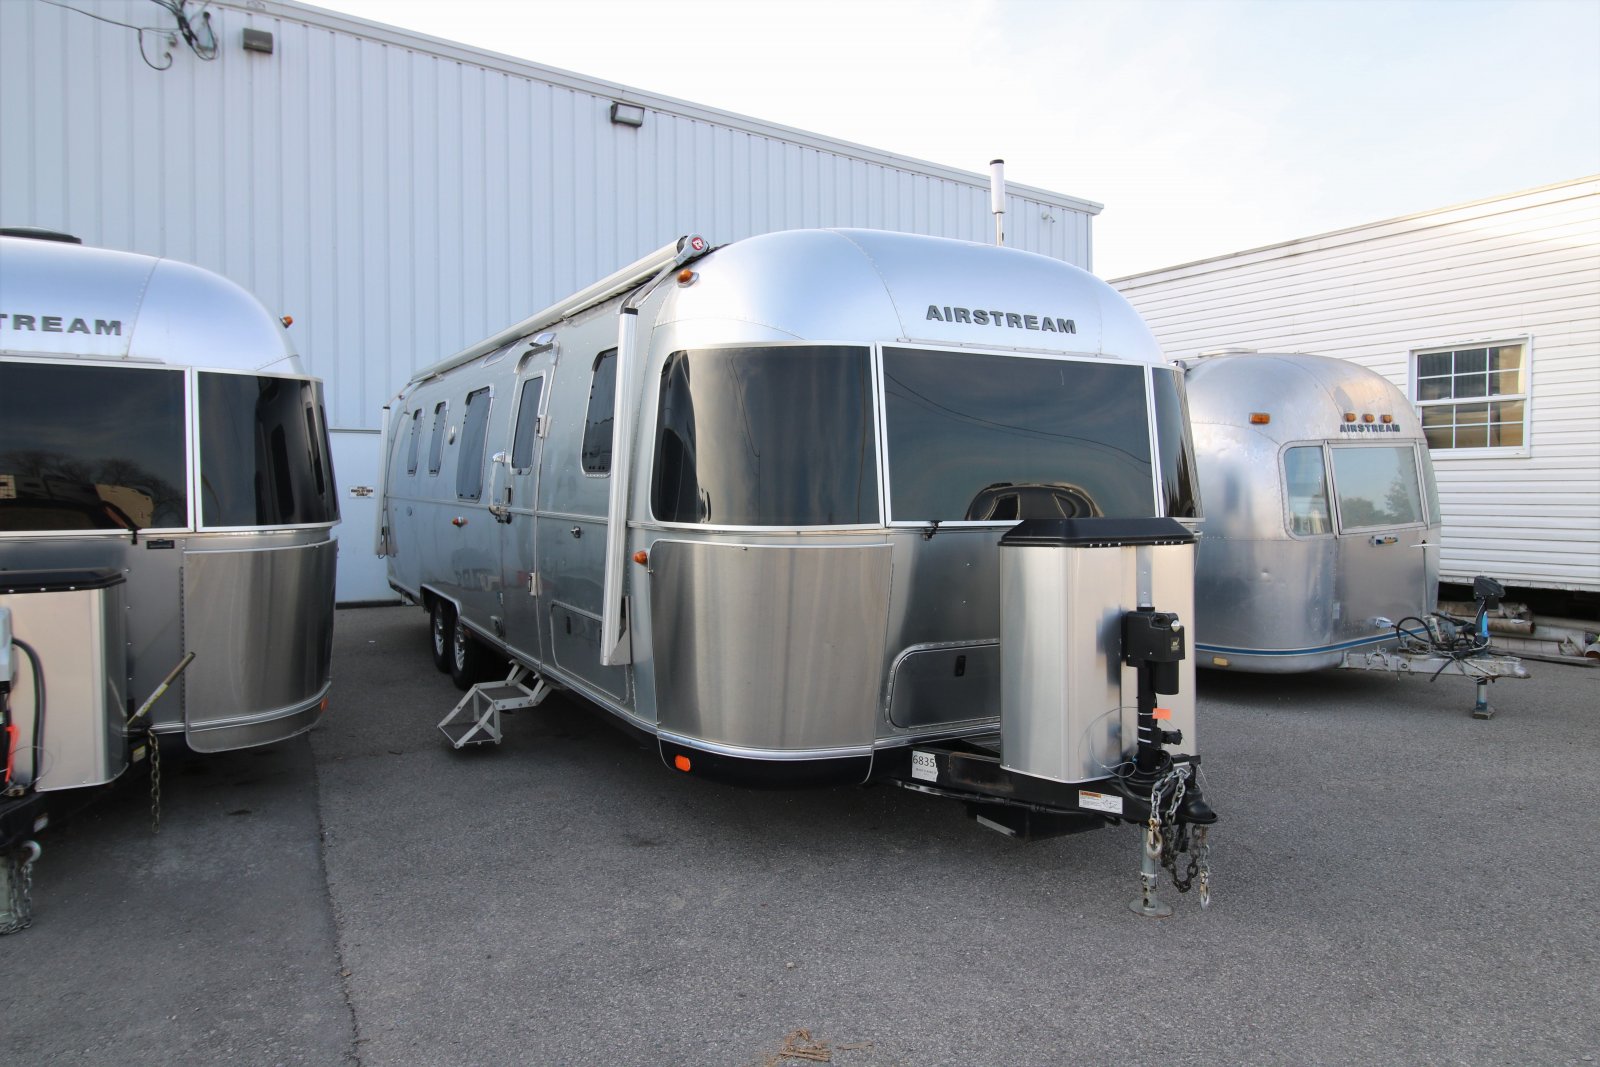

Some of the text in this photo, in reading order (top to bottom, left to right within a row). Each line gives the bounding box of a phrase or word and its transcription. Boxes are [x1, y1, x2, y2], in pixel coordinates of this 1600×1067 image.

[926, 304, 1077, 334] AIRSTREAM
[1340, 424, 1400, 432] AIRSTREAM
[913, 755, 935, 767] 6835
